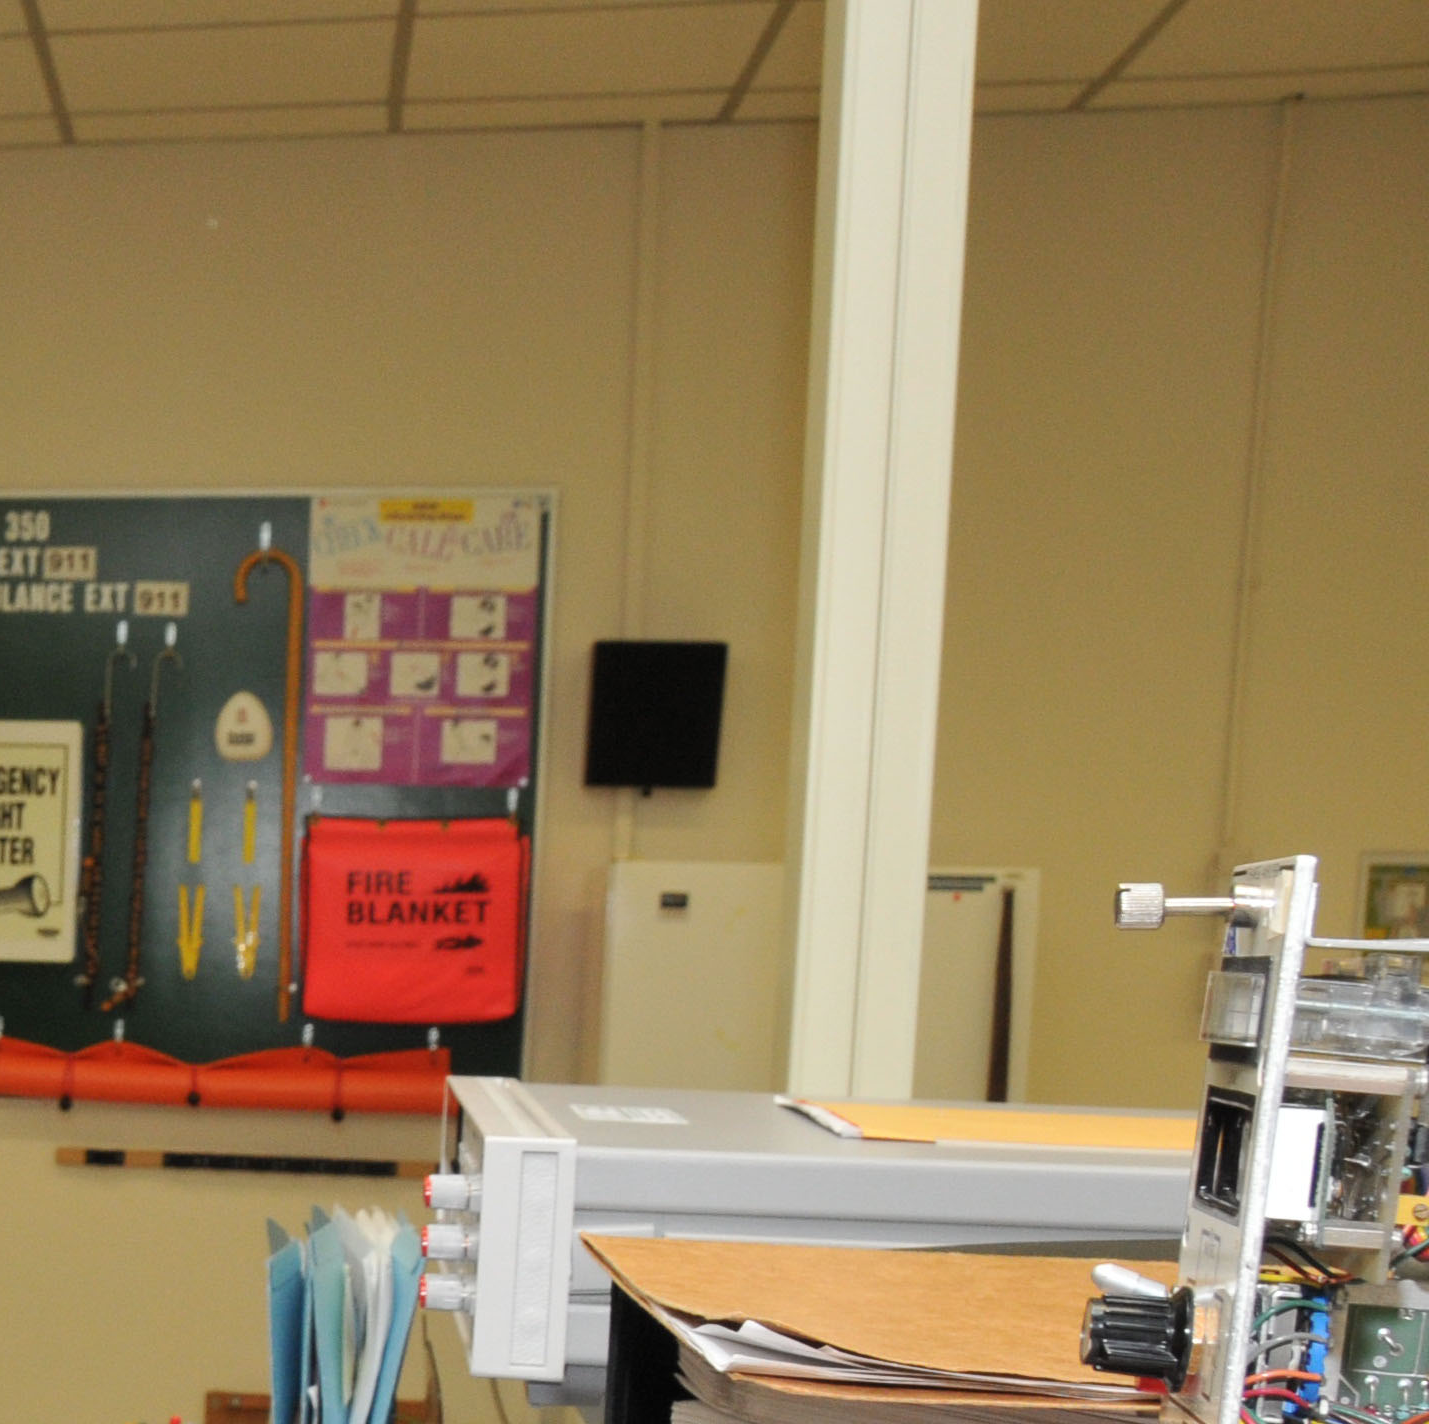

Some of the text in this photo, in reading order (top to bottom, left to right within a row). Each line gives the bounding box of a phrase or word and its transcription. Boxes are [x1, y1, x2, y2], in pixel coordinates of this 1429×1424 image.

[5, 511, 51, 541] 350
[48, 550, 91, 573] 911
[84, 583, 130, 612] EXT
[140, 591, 182, 611] 911
[347, 871, 413, 896] FIRE
[347, 901, 489, 925] BLANKET
